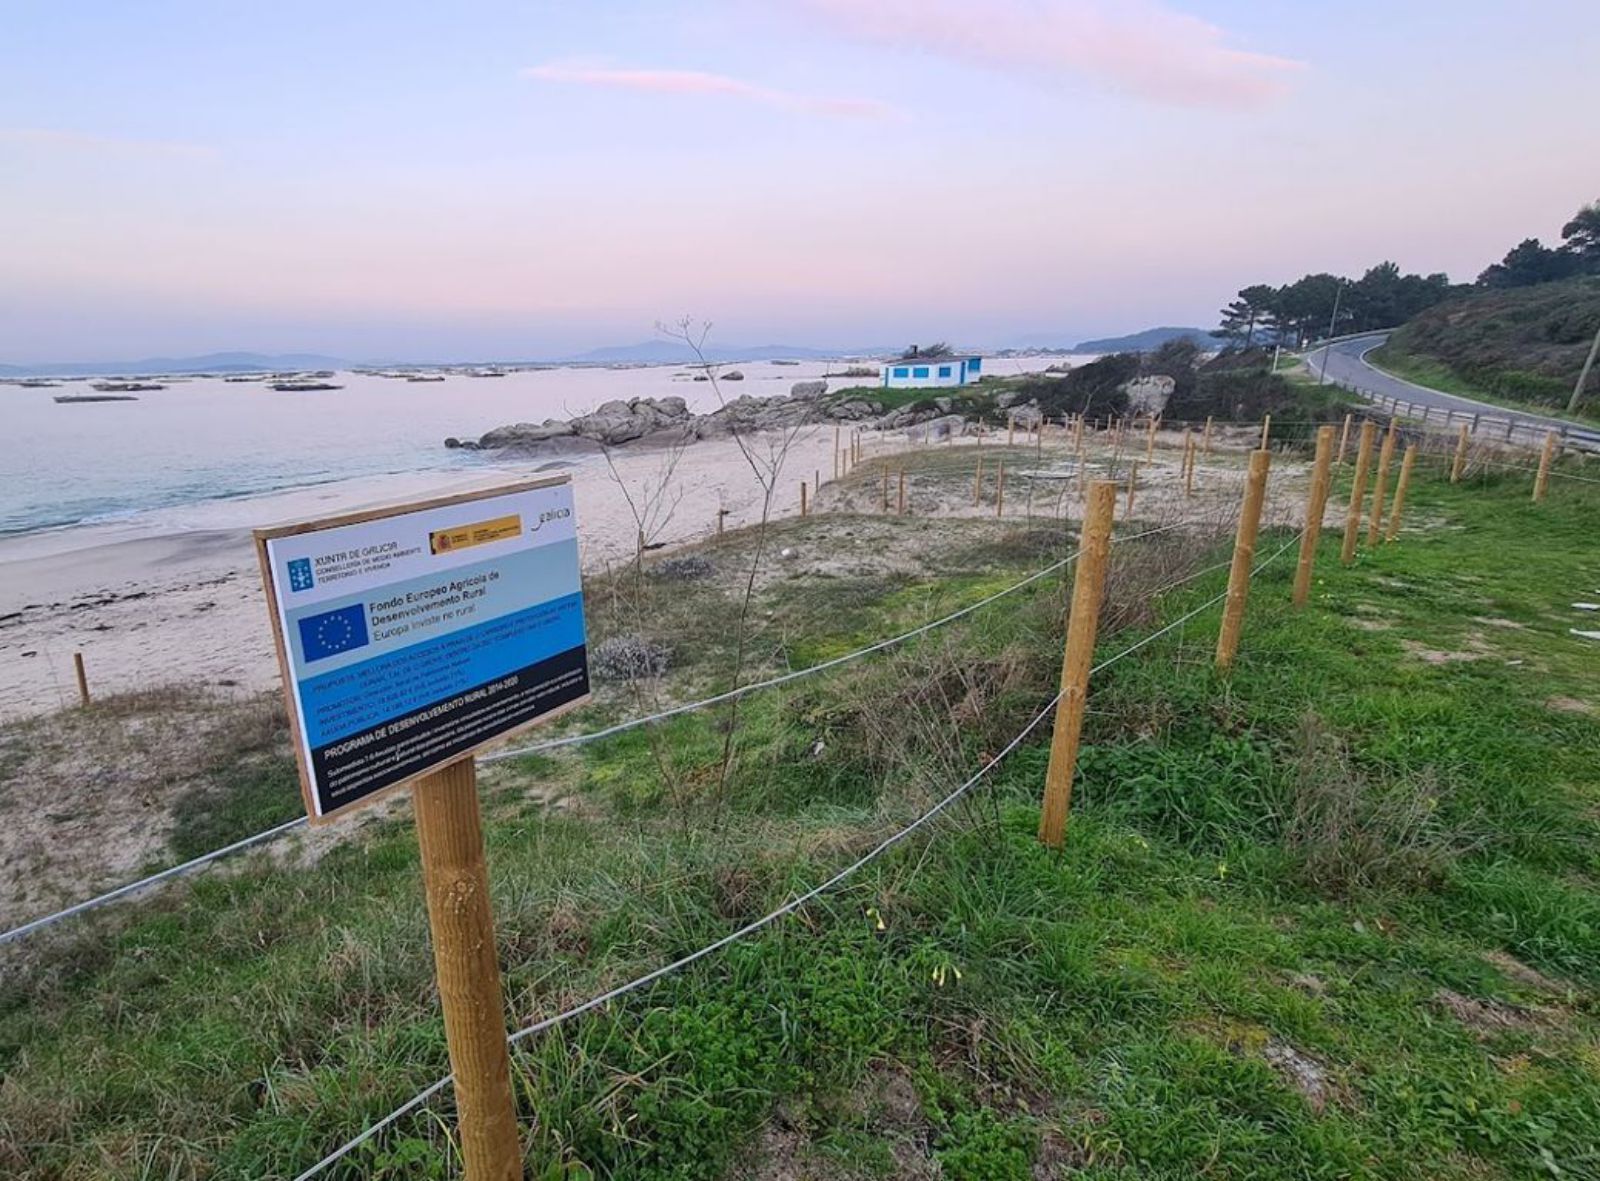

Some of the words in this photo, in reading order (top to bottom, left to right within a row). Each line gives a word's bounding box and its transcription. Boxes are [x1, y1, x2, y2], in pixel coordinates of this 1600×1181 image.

[348, 548, 360, 559] DE
[369, 596, 404, 614] Fondo
[406, 583, 448, 606] Europeo
[489, 570, 499, 581] de
[371, 593, 460, 627] Desenvolvemento
[462, 585, 486, 601] Rural
[373, 622, 409, 644] Europa
[410, 612, 441, 630] inviste
[442, 610, 454, 621] no
[455, 602, 476, 617] rural
[323, 731, 375, 760] PROGRAMA
[374, 726, 386, 740] DE
[388, 696, 464, 734] DESENVOLVEMENTO
[464, 687, 487, 704] RURAL
